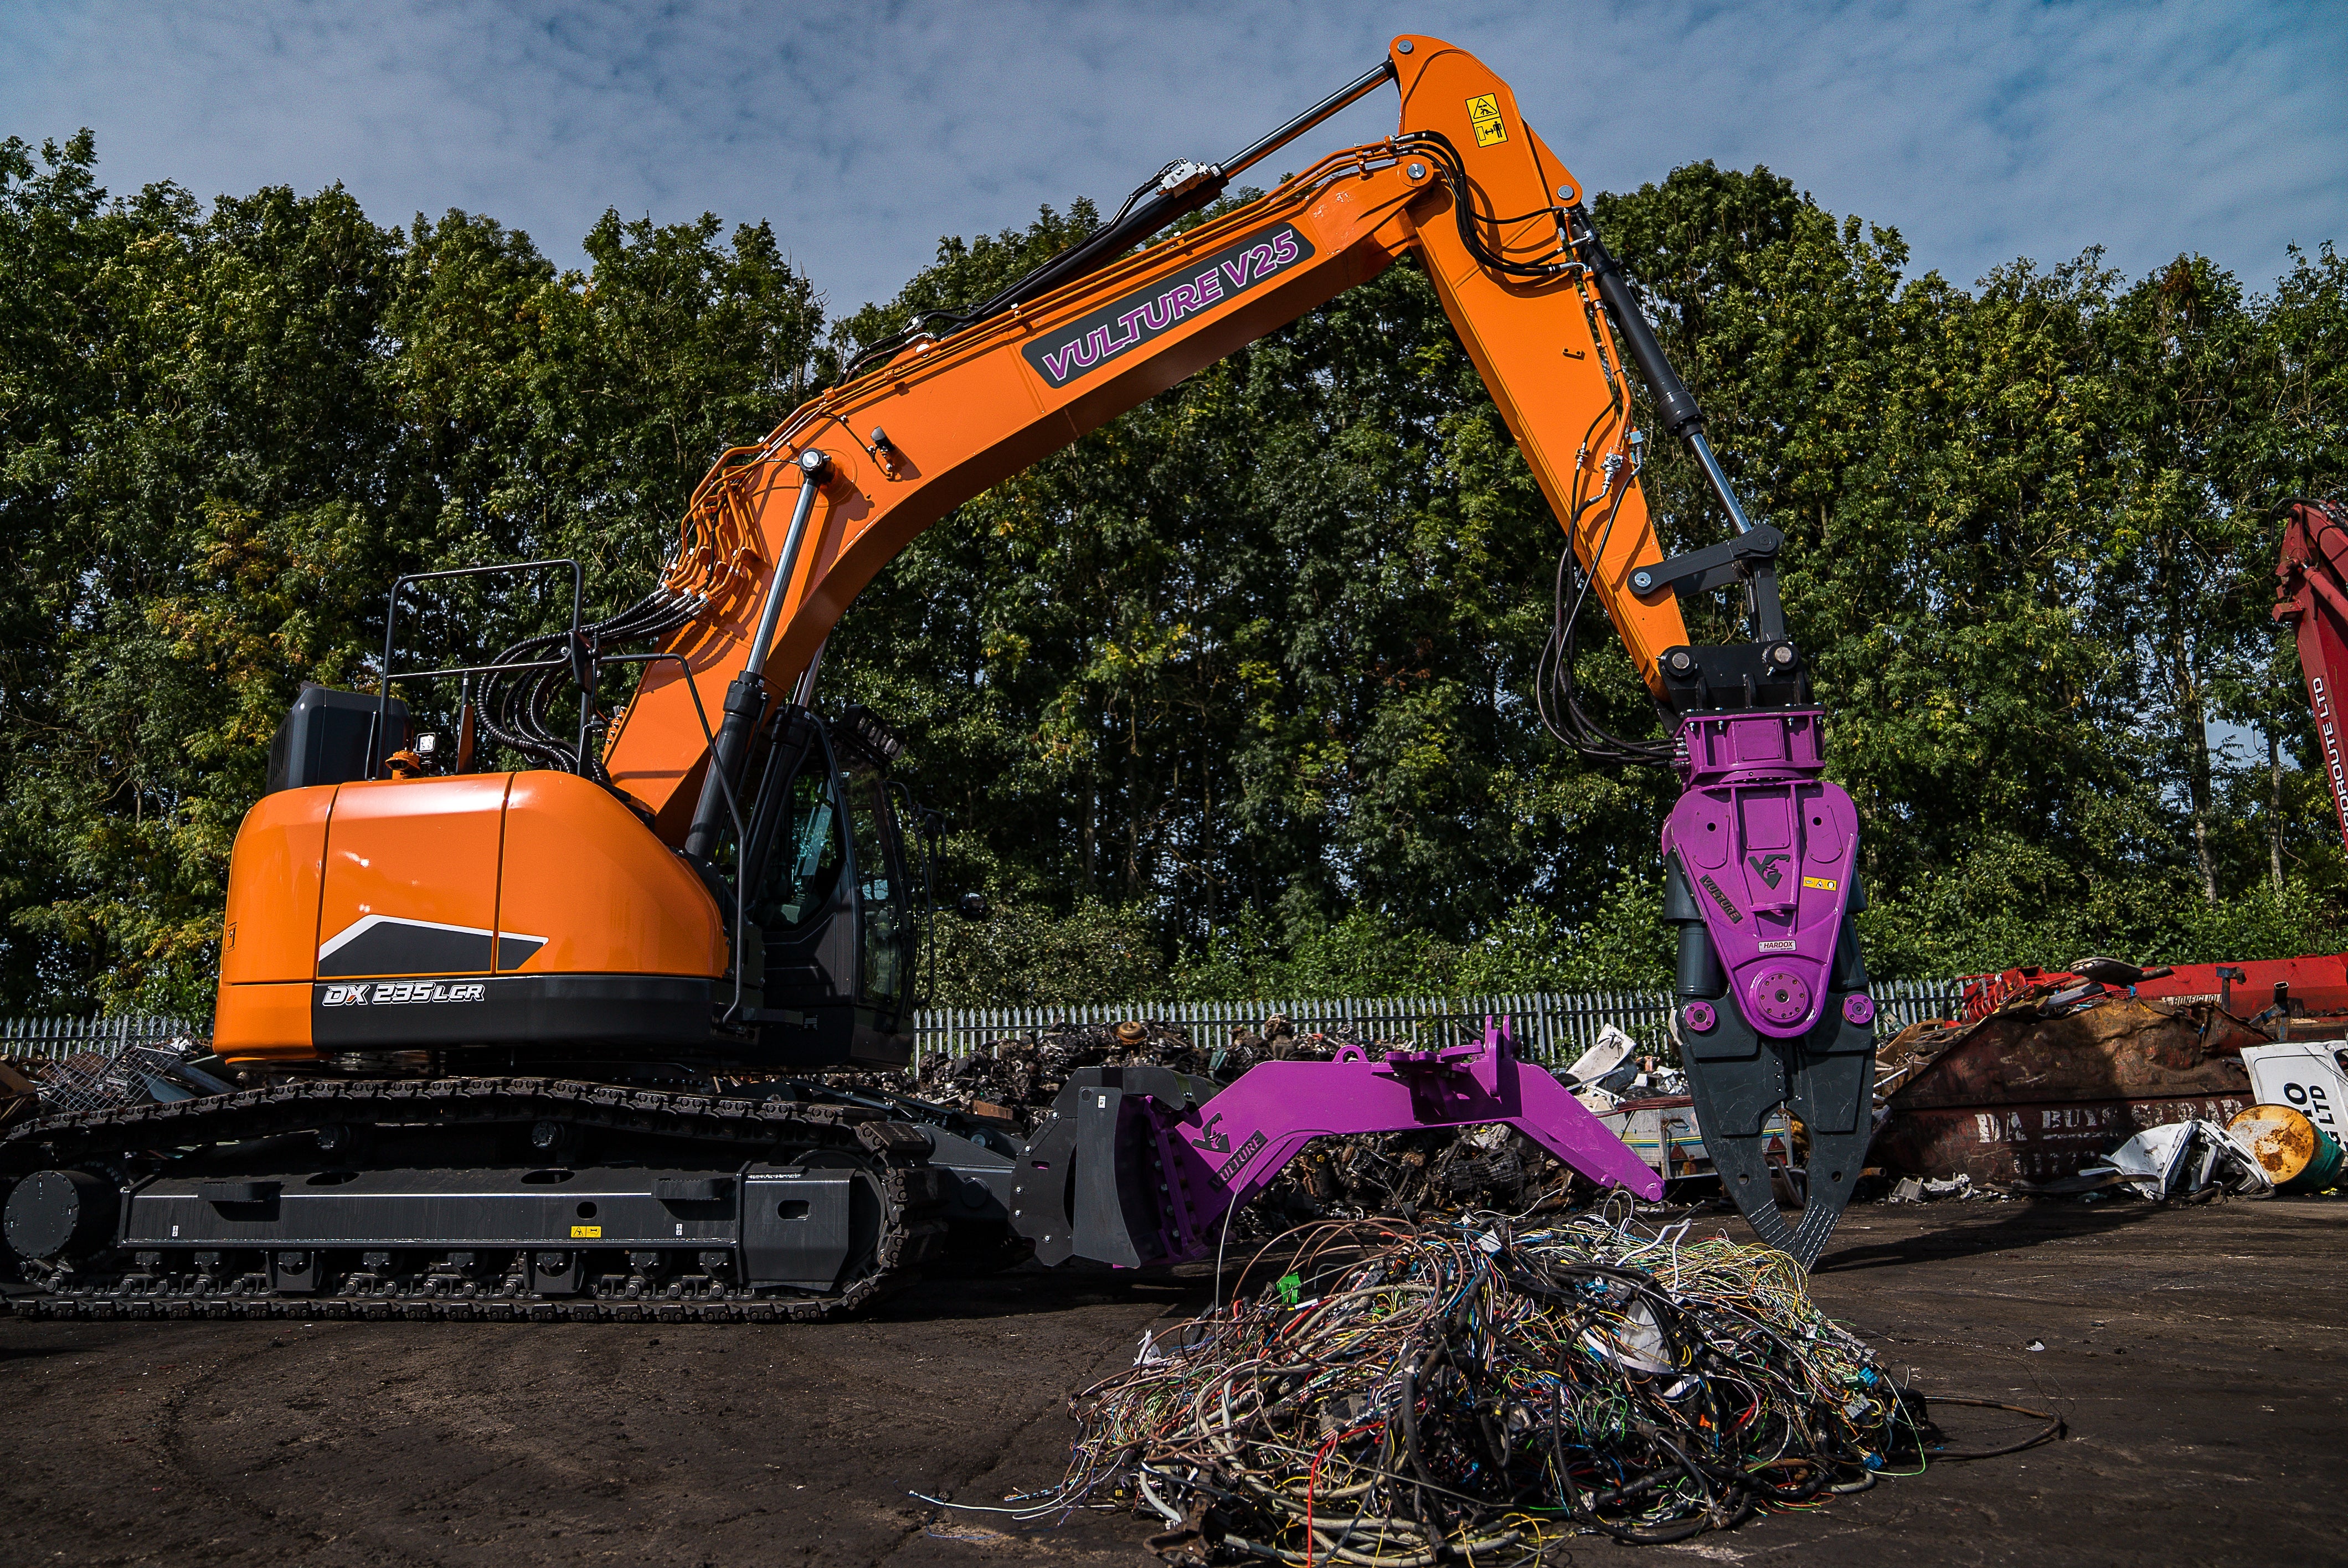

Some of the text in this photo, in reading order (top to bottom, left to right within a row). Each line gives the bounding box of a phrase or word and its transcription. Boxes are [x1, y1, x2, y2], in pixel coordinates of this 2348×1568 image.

[1042, 229, 1298, 381] VULTURE V25
[2313, 677, 2348, 833] ROROUTE LTD
[1703, 877, 1739, 918] VULTURE
[322, 984, 369, 1006] DX
[2309, 1085, 2335, 1125] LTD
[1211, 1135, 1261, 1187] VULTURE
